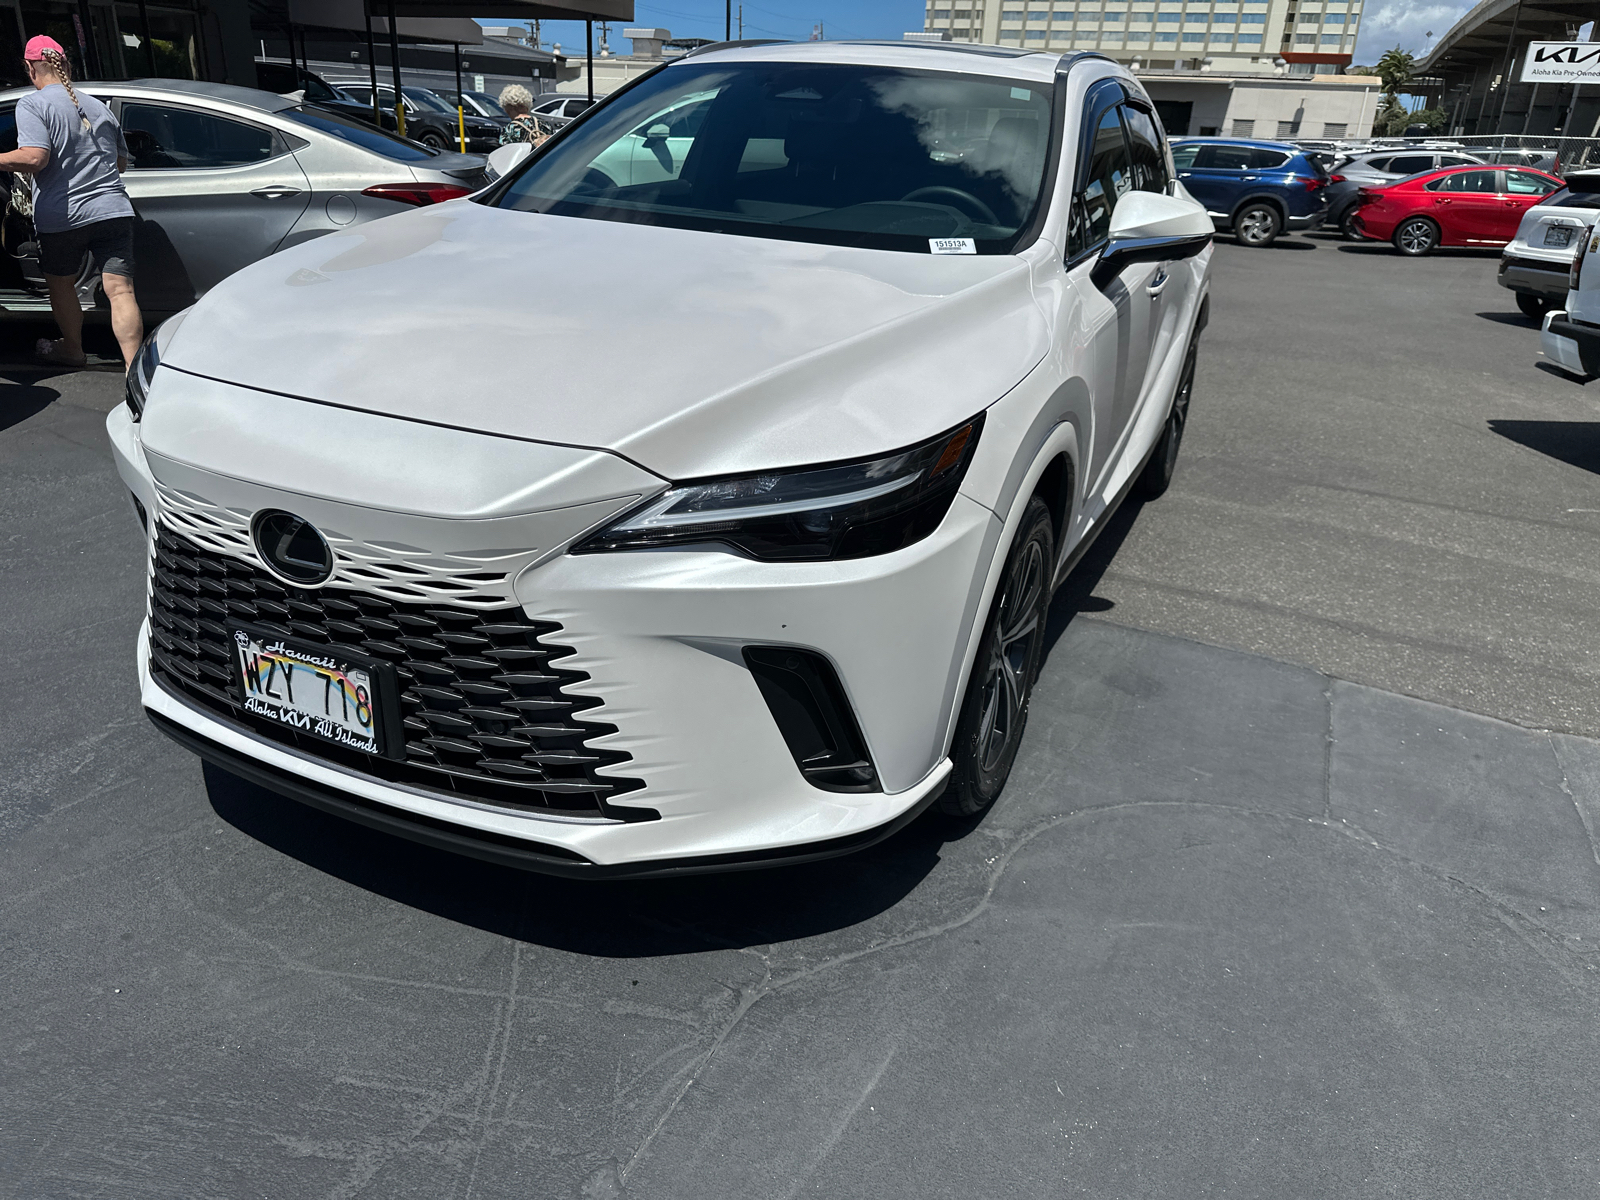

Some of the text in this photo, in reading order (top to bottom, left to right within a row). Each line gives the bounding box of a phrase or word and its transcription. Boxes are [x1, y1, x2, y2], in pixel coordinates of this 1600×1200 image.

[934, 240, 967, 248] 151513A
[266, 642, 336, 669] Hawaii
[241, 648, 371, 728] WZY 718
[245, 698, 278, 719] Aloha
[280, 707, 311, 730] KIA
[315, 720, 333, 738] All
[335, 727, 379, 754] Islands
